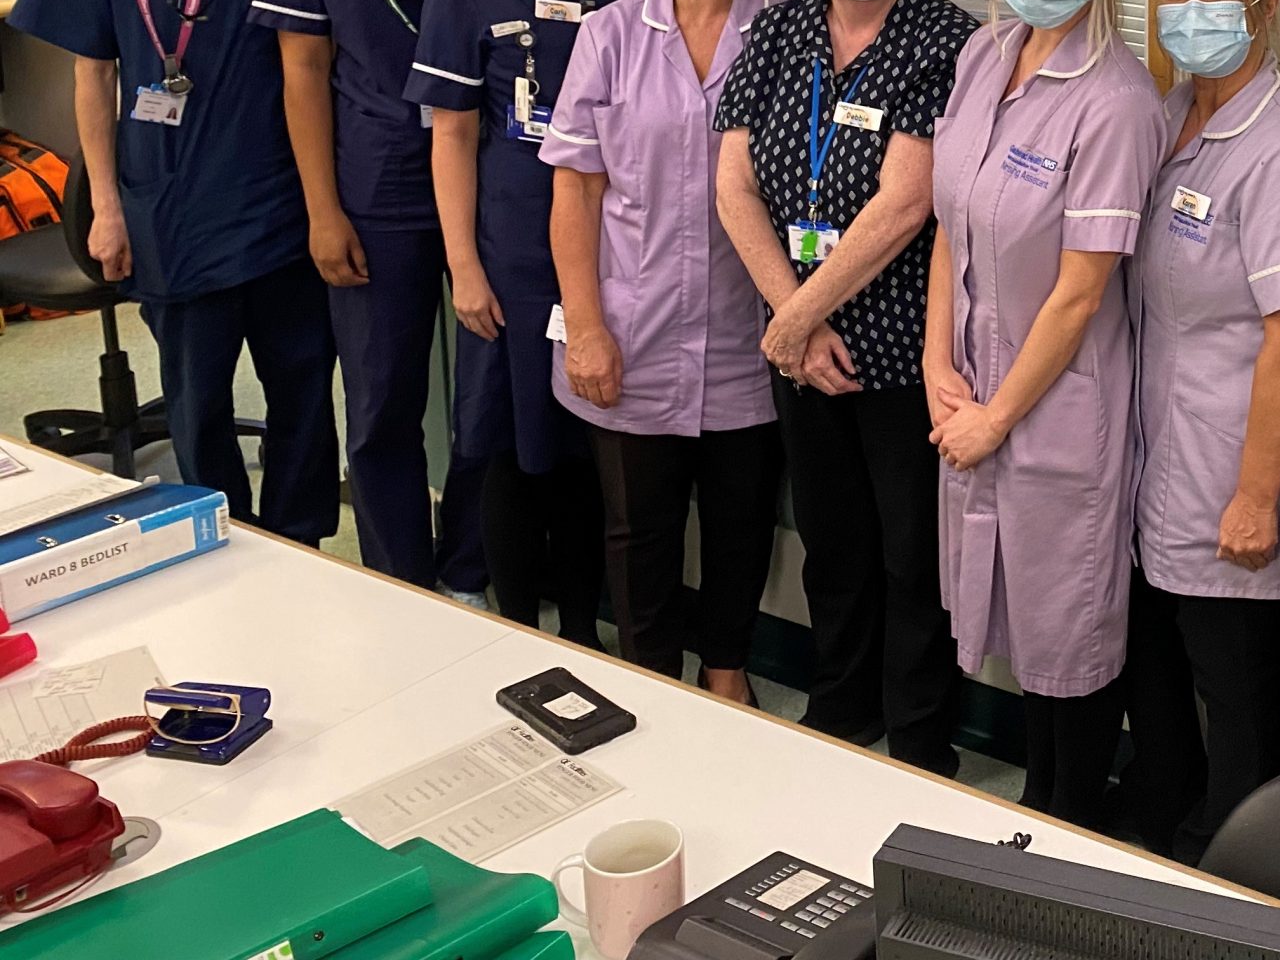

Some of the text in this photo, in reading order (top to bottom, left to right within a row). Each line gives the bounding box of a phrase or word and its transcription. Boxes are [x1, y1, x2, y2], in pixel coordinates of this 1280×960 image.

[25, 542, 129, 587] WARD 8 BEDLIST
